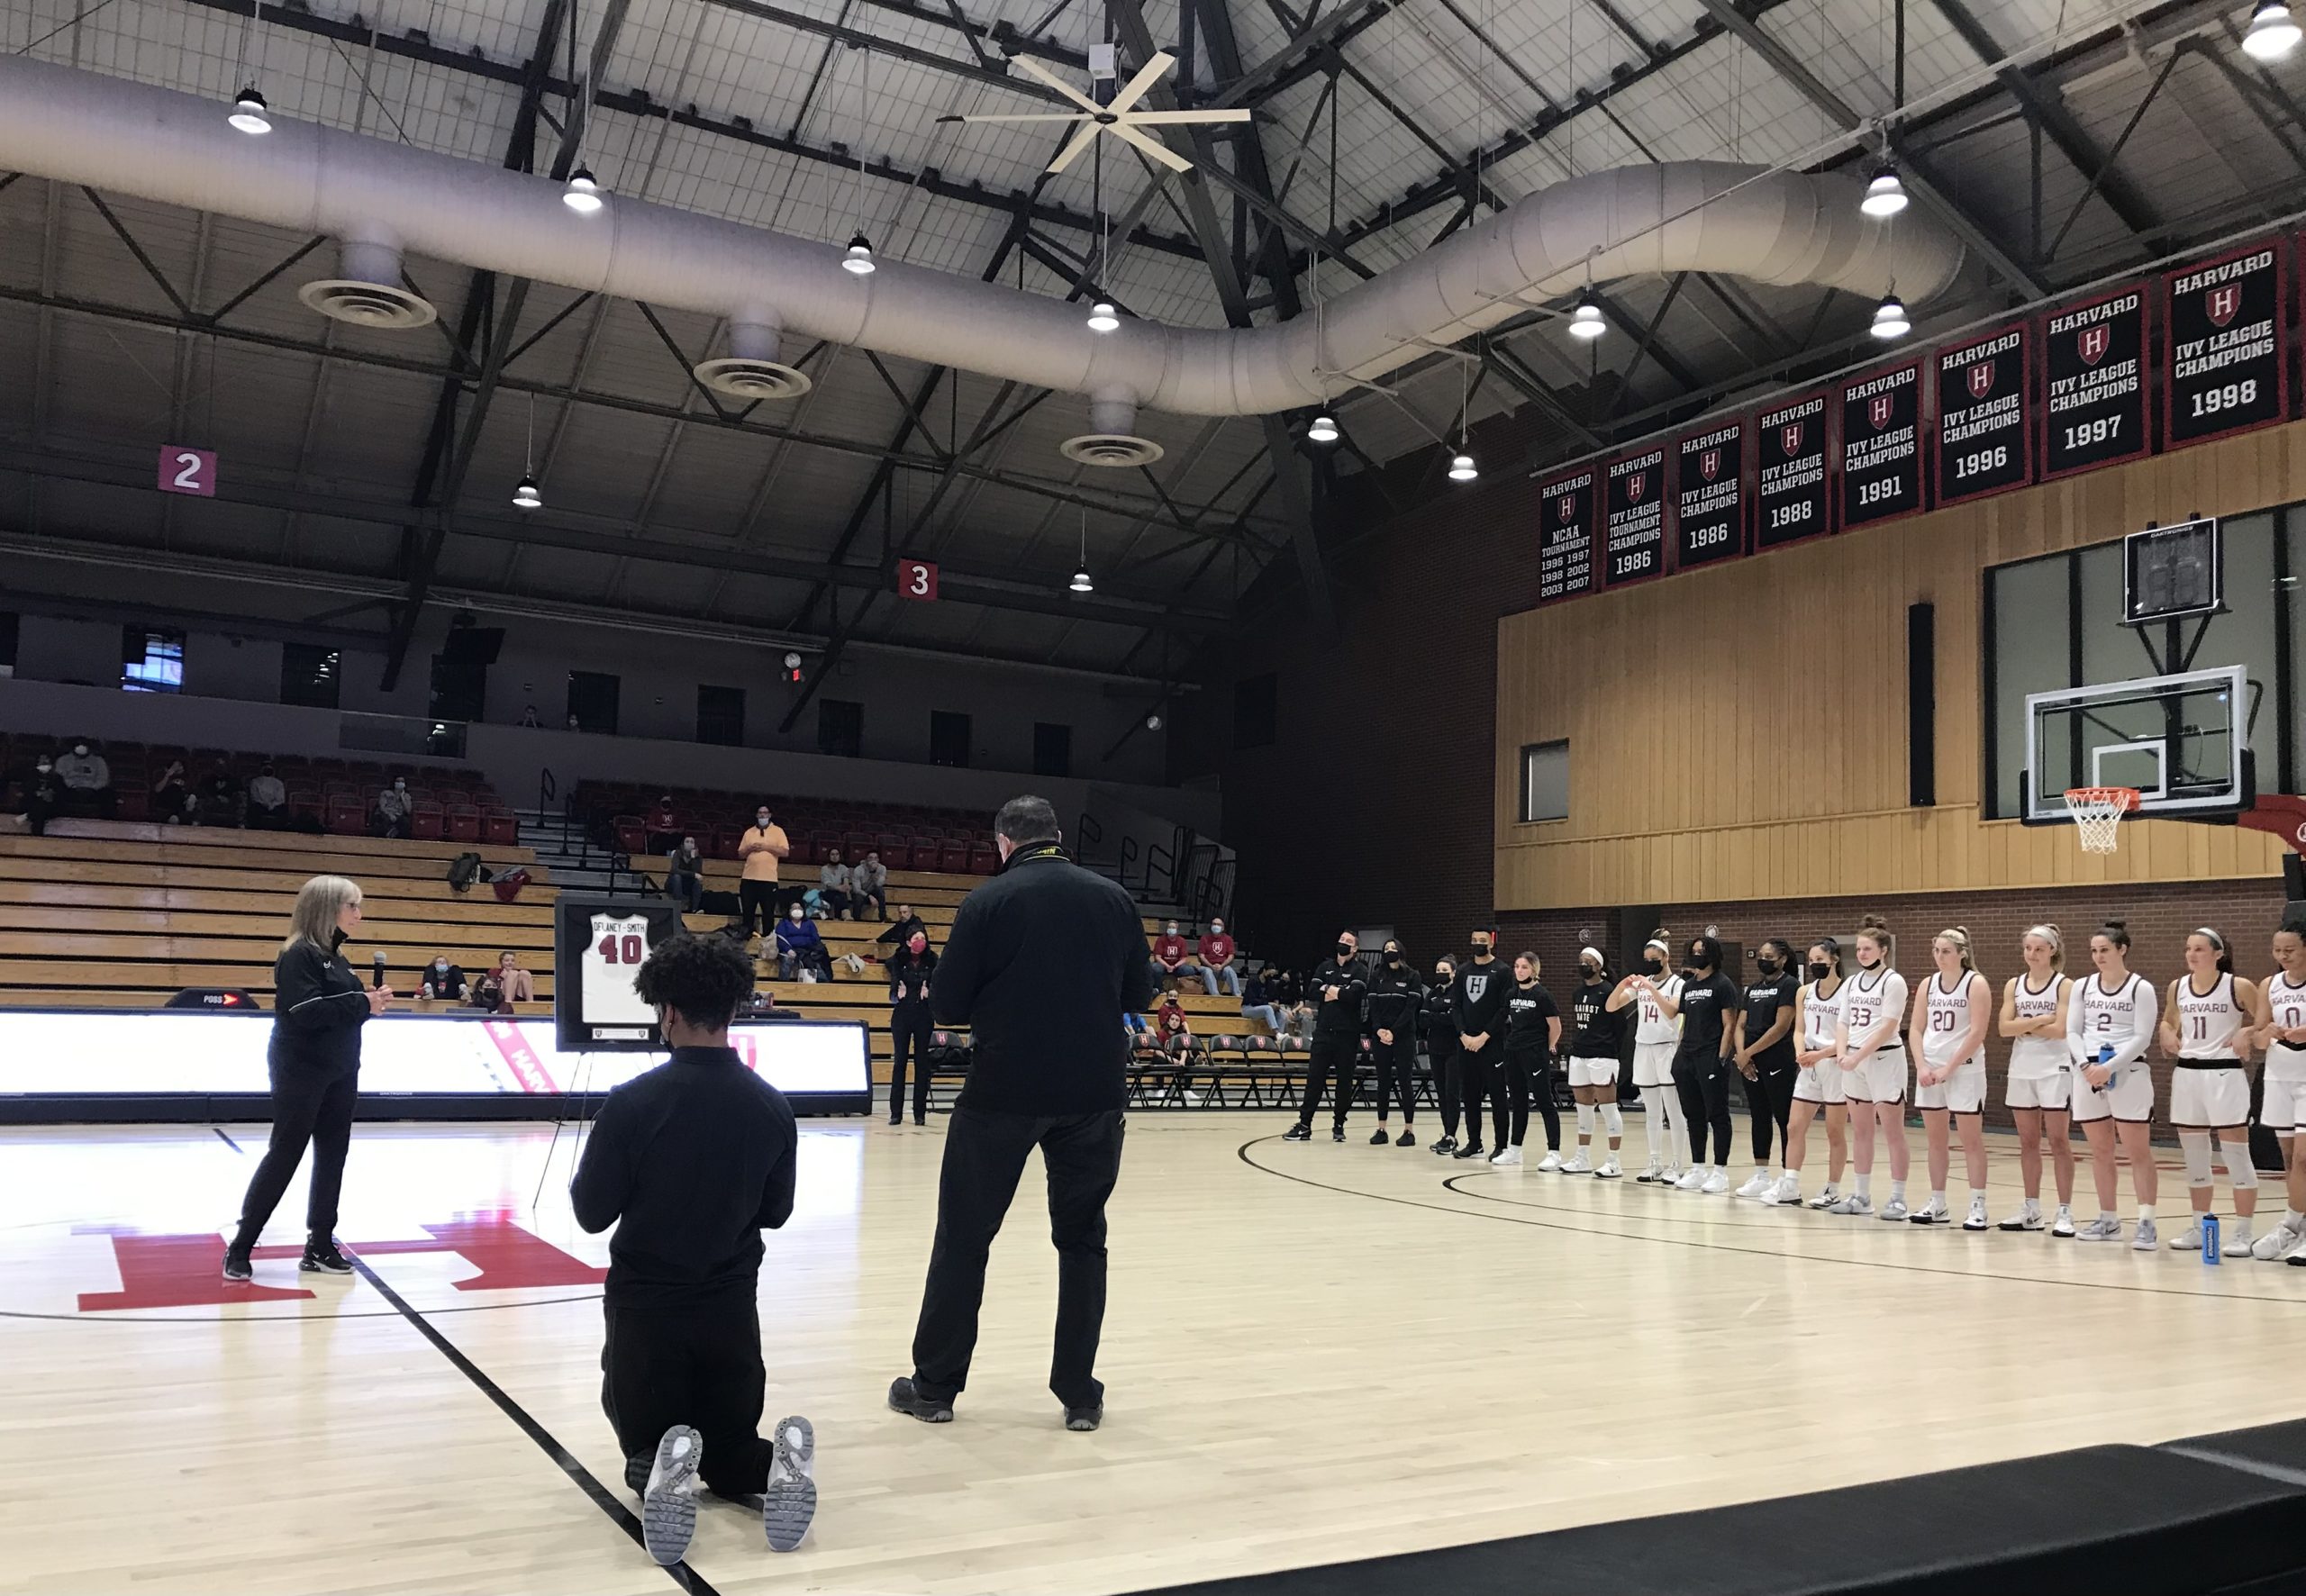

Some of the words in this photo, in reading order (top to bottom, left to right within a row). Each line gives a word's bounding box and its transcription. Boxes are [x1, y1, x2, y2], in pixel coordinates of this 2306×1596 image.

[2174, 250, 2273, 295] HARVARD
[2049, 295, 2138, 335] HARVARD
[2214, 288, 2232, 317] H
[1942, 332, 2020, 370] HARVARD
[2085, 330, 2102, 356] H
[2175, 340, 2205, 360] IVY
[2209, 319, 2273, 353] LEAGUE
[2175, 338, 2274, 379] CHAMPIONS
[1847, 367, 1915, 402] HARVARD
[1974, 366, 1988, 390] H
[2051, 376, 2077, 396] IVY
[2080, 359, 2137, 388] LEAGUE
[2050, 376, 2138, 413] CHAMPIONS
[2192, 379, 2256, 417] 1998
[1762, 398, 1823, 430] HARVARD
[1875, 398, 1887, 422] H
[1943, 410, 1966, 429] IVY
[1969, 394, 2020, 422] LEAGUE
[1682, 425, 1739, 454] HARVARD
[1786, 427, 1798, 448] H
[1943, 410, 2020, 444] CHAMPIONS
[2065, 414, 2121, 449] 1997
[1847, 440, 1867, 457] IVY
[1870, 425, 1913, 450] LEAGUE
[1610, 451, 1662, 477] HARVARD
[1705, 455, 1716, 473] H
[1762, 466, 1783, 483] IVY
[1784, 453, 1822, 477] LEAGUE
[1847, 441, 1914, 472] CHAMPIONS
[1956, 446, 2007, 478] 1996
[174, 453, 201, 488] 2
[1761, 467, 1823, 496] CHAMPIONS
[1542, 474, 1592, 499] HARVARD
[1630, 476, 1640, 495] H
[1681, 490, 1699, 505] IVY
[1701, 478, 1738, 501] LEAGUE
[1859, 476, 1902, 505] 1991
[1561, 498, 1571, 517] H
[1610, 511, 1625, 526] IVY
[1627, 500, 1661, 521] LEAGUE
[1681, 493, 1738, 519] CHAMPIONS
[1771, 500, 1812, 529] 1988
[1552, 525, 1579, 544] NCAA
[1610, 513, 1661, 539] TOURNAMENT
[1689, 523, 1728, 549] 1986
[1542, 536, 1590, 558] TOURNAMENT
[1609, 528, 1661, 552] CHAMPIONS
[1541, 557, 1563, 571] 1996
[1567, 549, 1589, 564] 1997
[1616, 550, 1651, 575] 1986
[911, 566, 928, 594] 3
[1541, 569, 1563, 584] 1998
[1566, 563, 1589, 577] 2002
[1541, 583, 1563, 597] 2003
[1566, 576, 1589, 590] 2007
[598, 935, 641, 964] 40
[1470, 977, 1483, 993] H
[204, 995, 222, 1003] POSS
[1644, 1005, 1659, 1023] 14
[1816, 1016, 1821, 1035] 1
[1851, 1008, 1872, 1027] 33
[1933, 1011, 1956, 1031] 20
[2097, 1013, 2111, 1031] 2
[2193, 1016, 2206, 1039] 11
